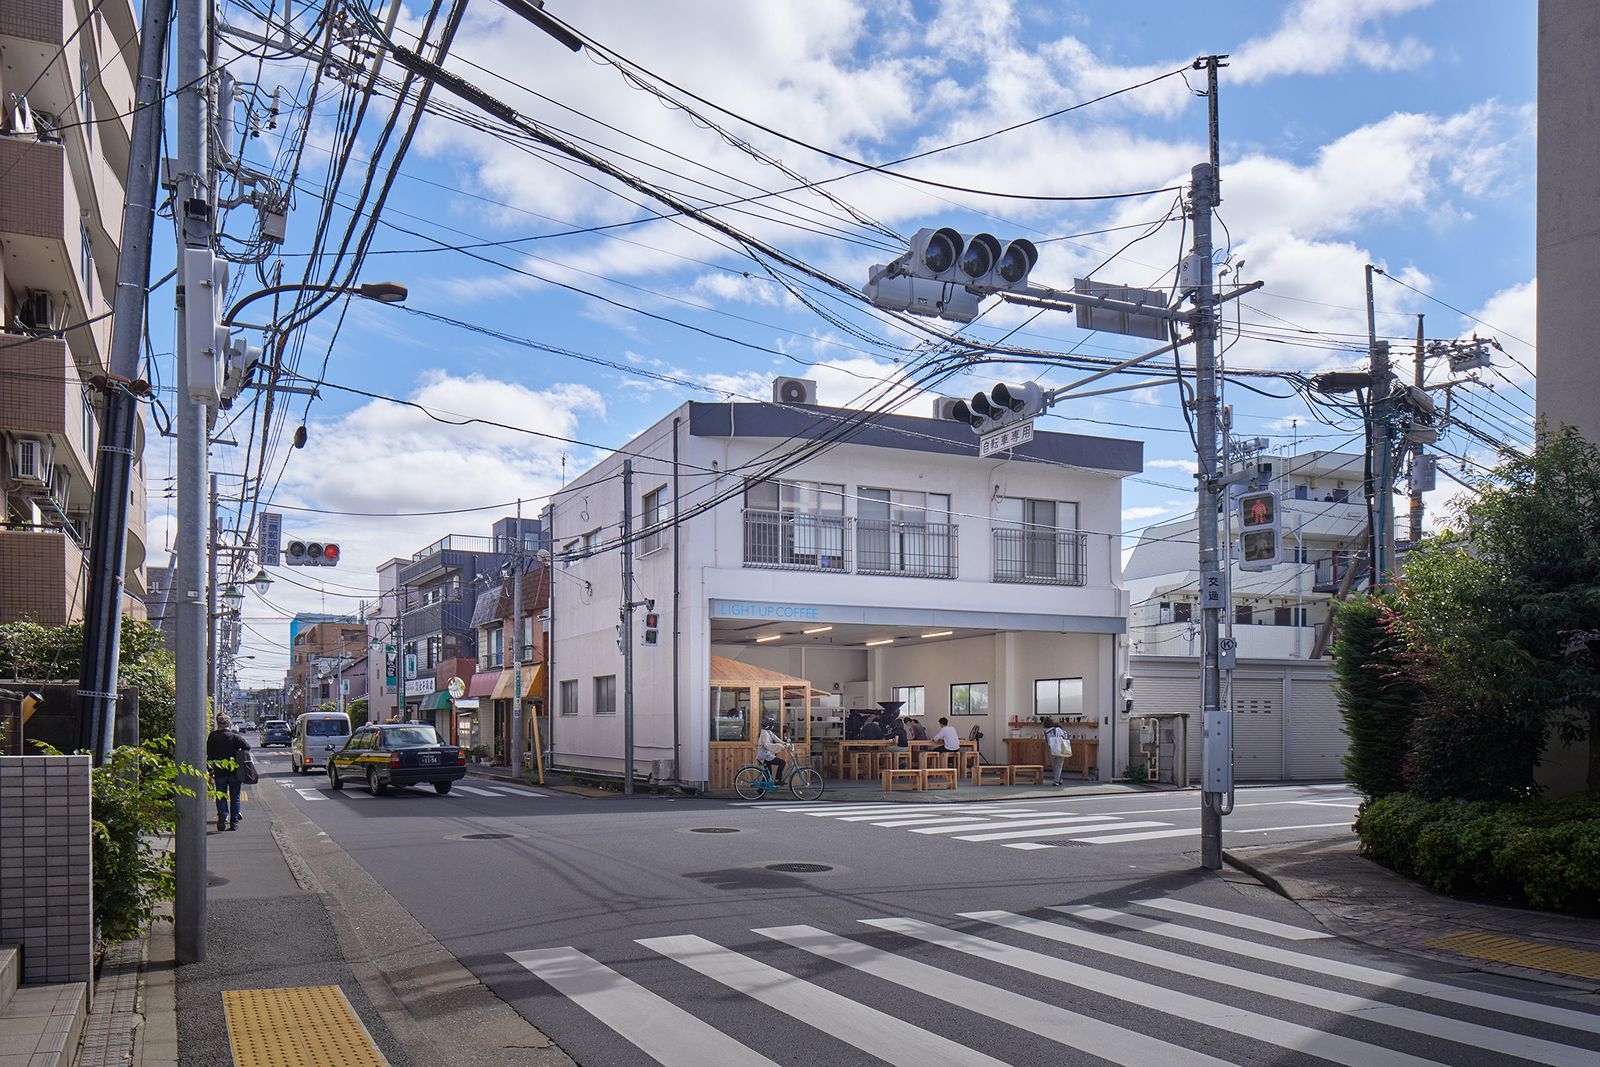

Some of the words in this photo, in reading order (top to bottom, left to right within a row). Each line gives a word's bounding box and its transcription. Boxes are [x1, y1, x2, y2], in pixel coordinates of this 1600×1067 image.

[982, 425, 1031, 454] 自転車専用
[1208, 577, 1219, 601] 交通
[720, 603, 757, 616] LIGHT
[759, 605, 775, 617] UP
[776, 606, 818, 619] COFFEE
